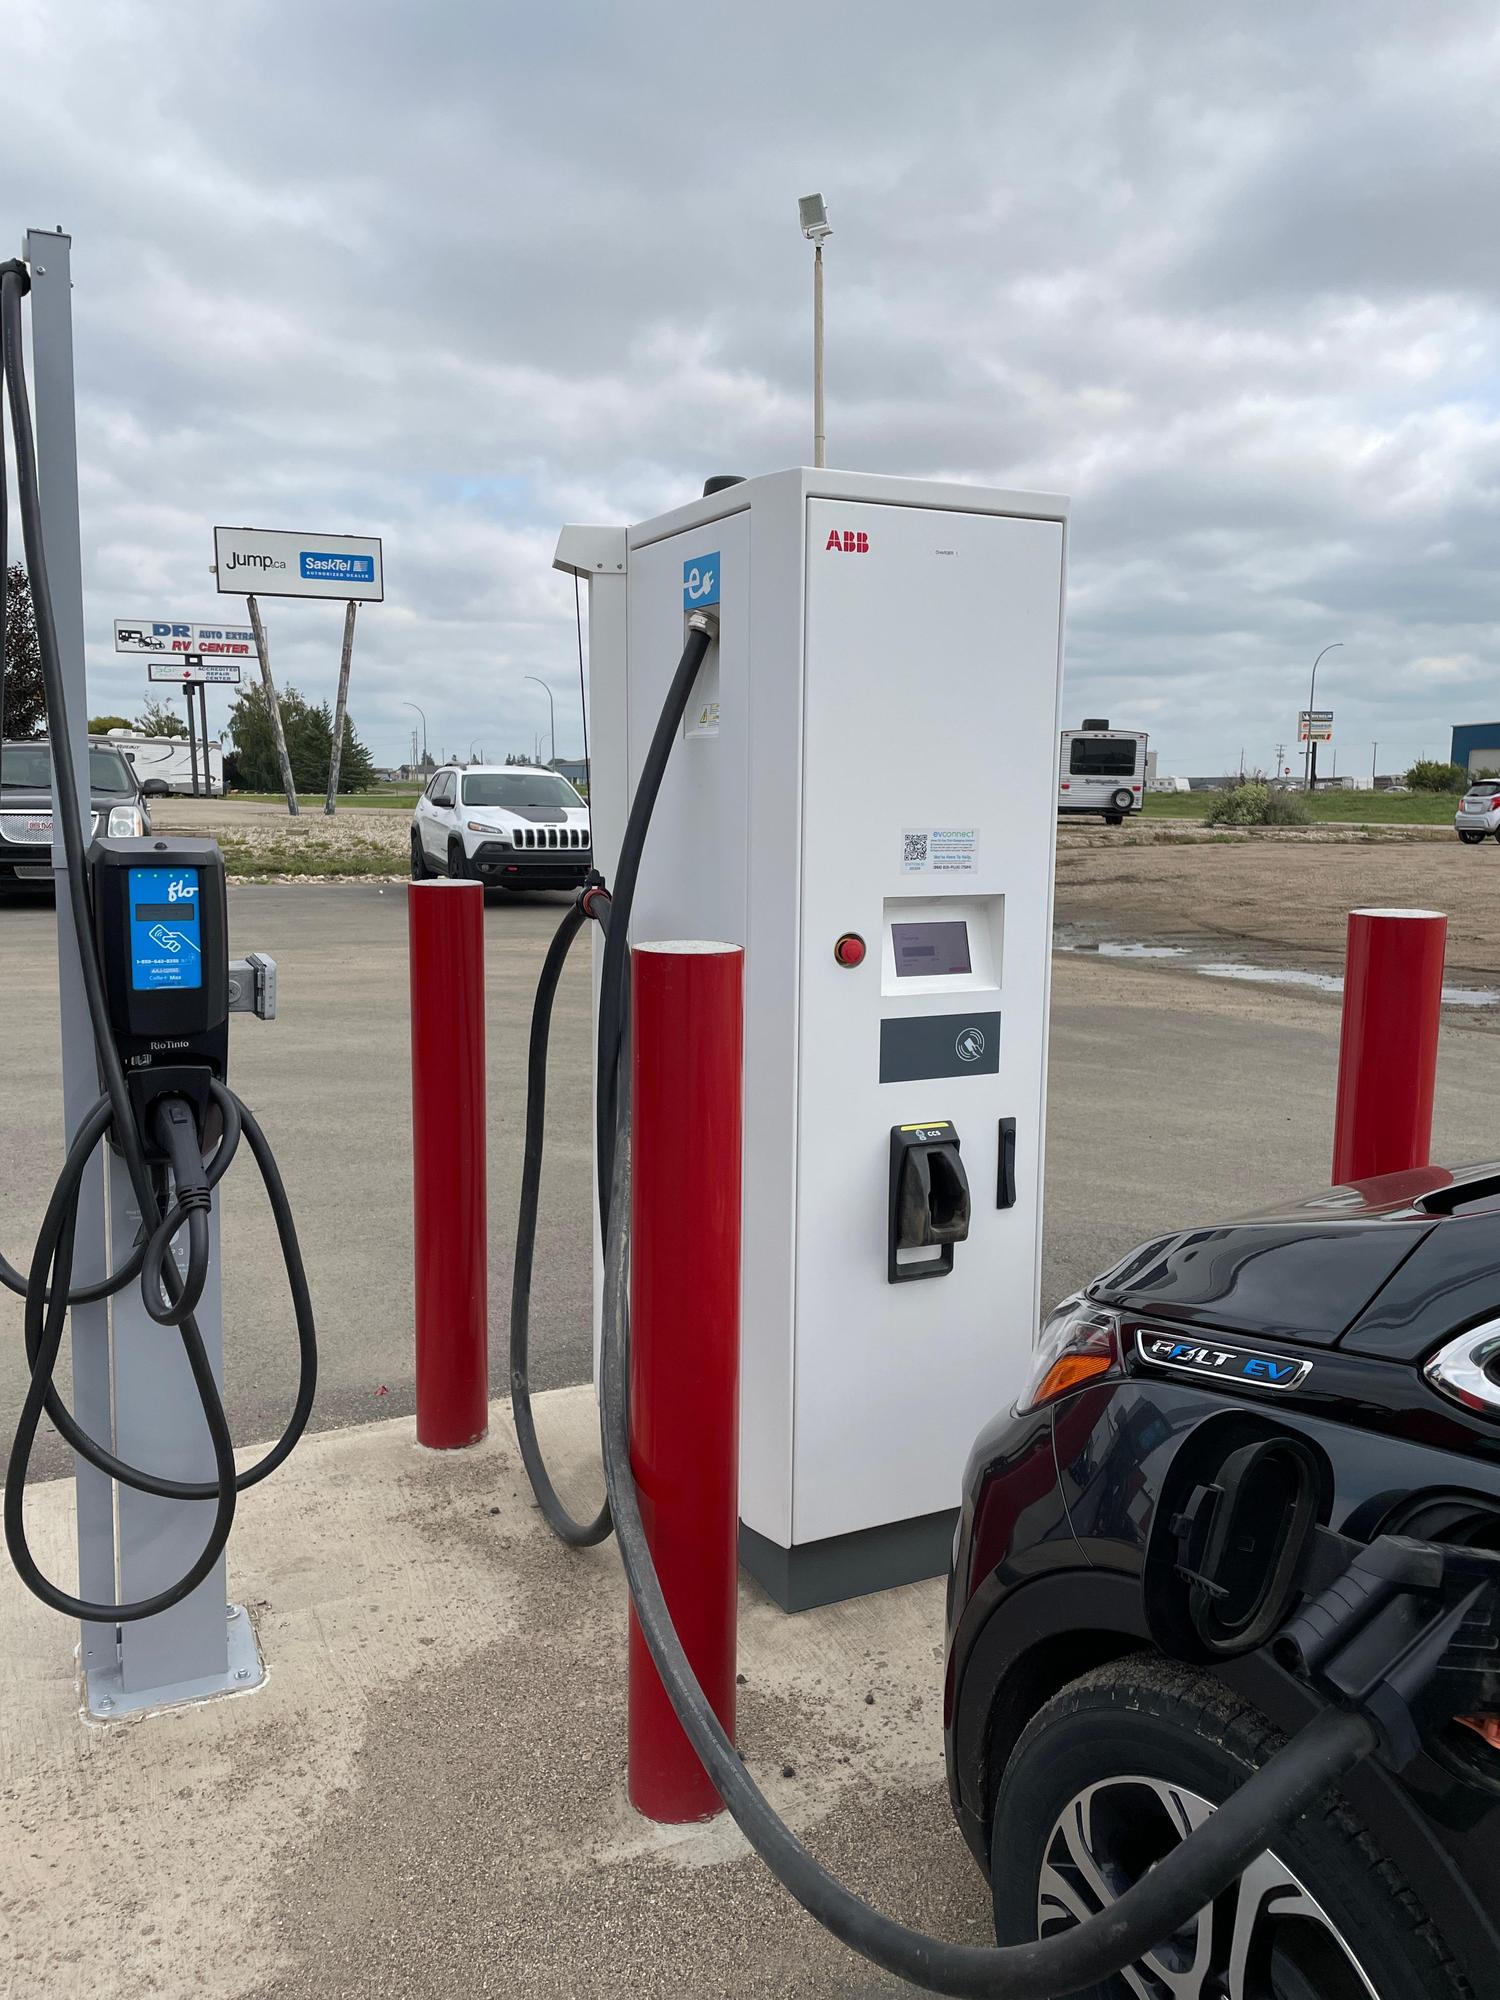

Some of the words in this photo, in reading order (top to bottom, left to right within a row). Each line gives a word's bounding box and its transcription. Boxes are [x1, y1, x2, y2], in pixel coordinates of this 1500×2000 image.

[825, 529, 870, 553] ABB
[305, 557, 351, 571] SaskTel
[306, 570, 344, 578] AUTHORIZED
[152, 623, 192, 638] DR
[198, 629, 223, 640] AUTO
[171, 640, 192, 652] RV
[198, 642, 250, 654] CENTER
[29, 822, 54, 830] GM
[1150, 1339, 1237, 1367] BOLT
[1242, 1358, 1294, 1381] EV
